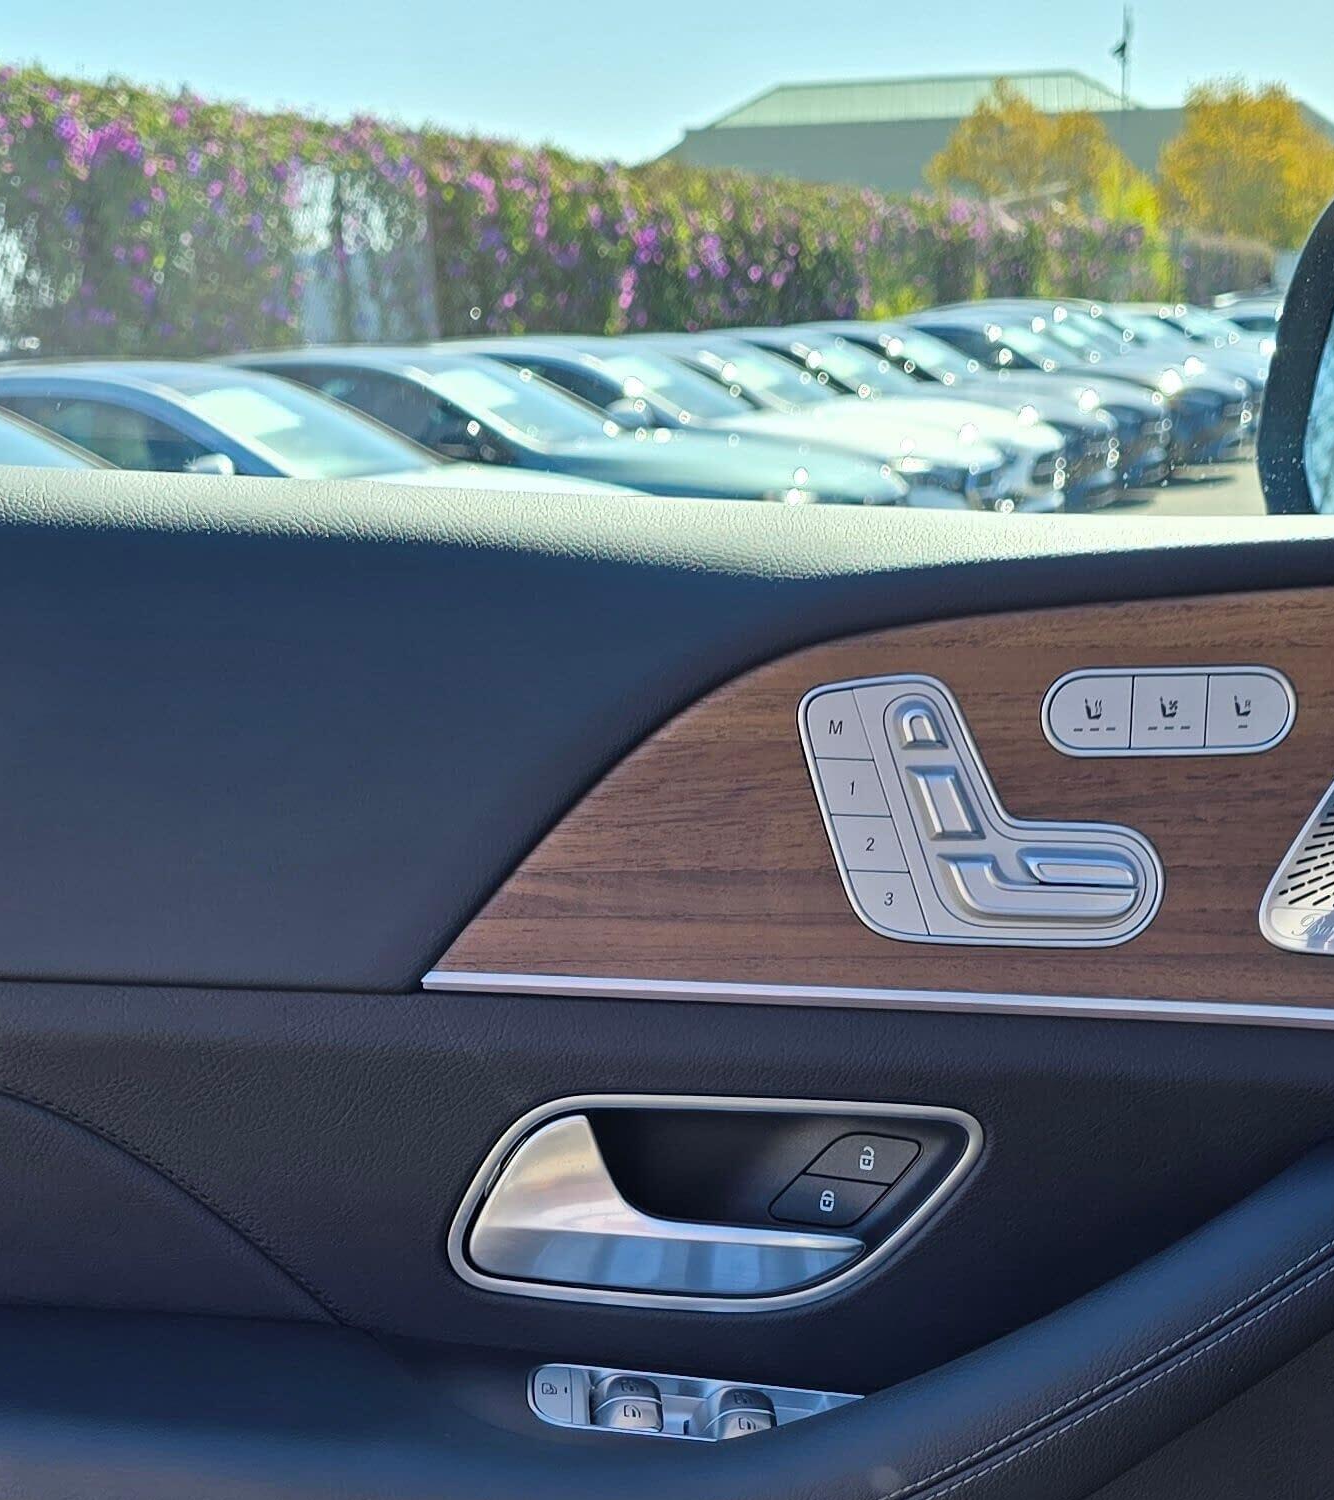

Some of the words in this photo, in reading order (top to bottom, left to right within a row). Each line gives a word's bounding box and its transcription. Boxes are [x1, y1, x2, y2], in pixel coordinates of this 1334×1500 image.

[827, 719, 844, 736] M
[848, 779, 857, 796] 1
[864, 836, 876, 852] 2
[882, 891, 895, 908] 3
